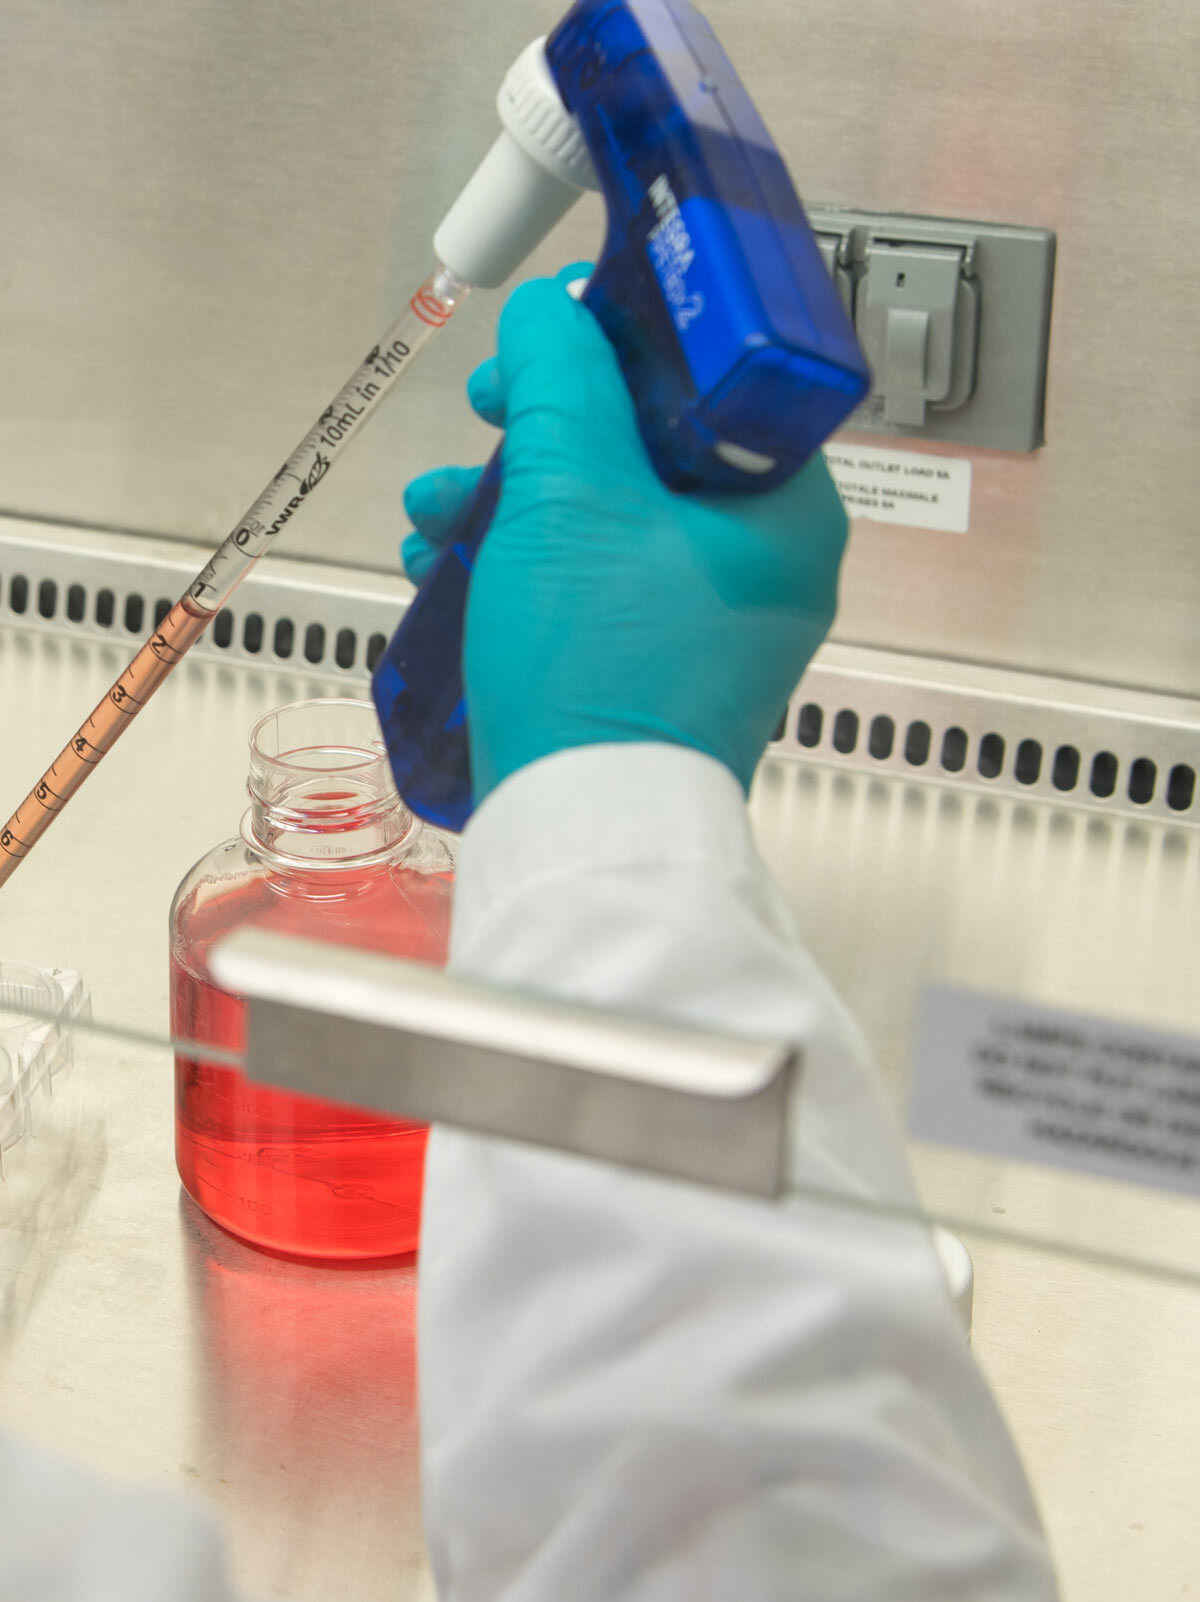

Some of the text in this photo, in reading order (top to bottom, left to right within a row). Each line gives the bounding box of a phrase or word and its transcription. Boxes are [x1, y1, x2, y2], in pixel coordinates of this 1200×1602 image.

[320, 403, 365, 449] 10mL
[356, 381, 381, 402] in
[374, 340, 411, 378] 1/10
[235, 528, 251, 546] 0
[194, 582, 207, 598] 1
[151, 634, 169, 654] 2
[112, 684, 127, 703] 3
[75, 737, 88, 752] 4
[36, 781, 50, 800] 5
[0, 830, 14, 847] 6
